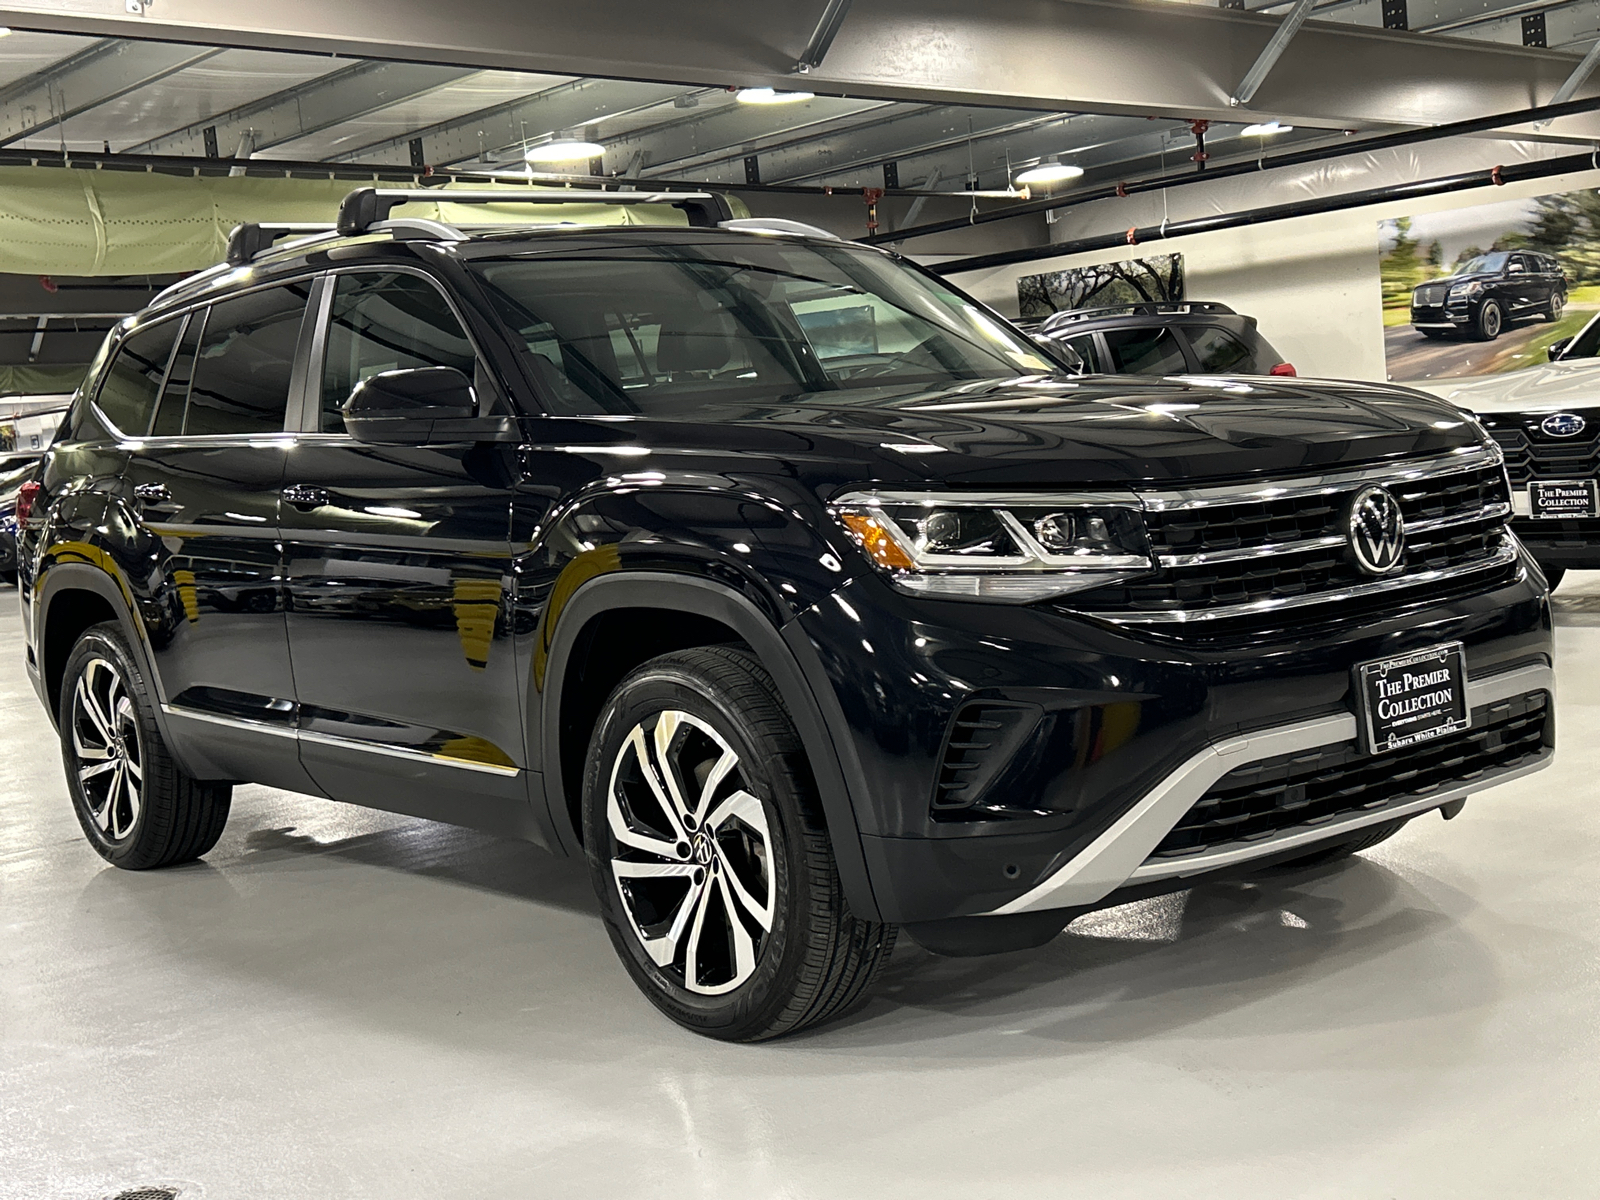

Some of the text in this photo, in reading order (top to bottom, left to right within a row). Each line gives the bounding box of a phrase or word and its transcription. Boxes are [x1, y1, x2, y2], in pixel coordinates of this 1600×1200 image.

[1537, 488, 1588, 498] THE PREMIER
[1538, 497, 1589, 507] COLLECTION
[1375, 669, 1451, 698] THE PREMIER
[1378, 689, 1452, 719] COLLECTION
[1388, 725, 1457, 748] Subaru White Plains
